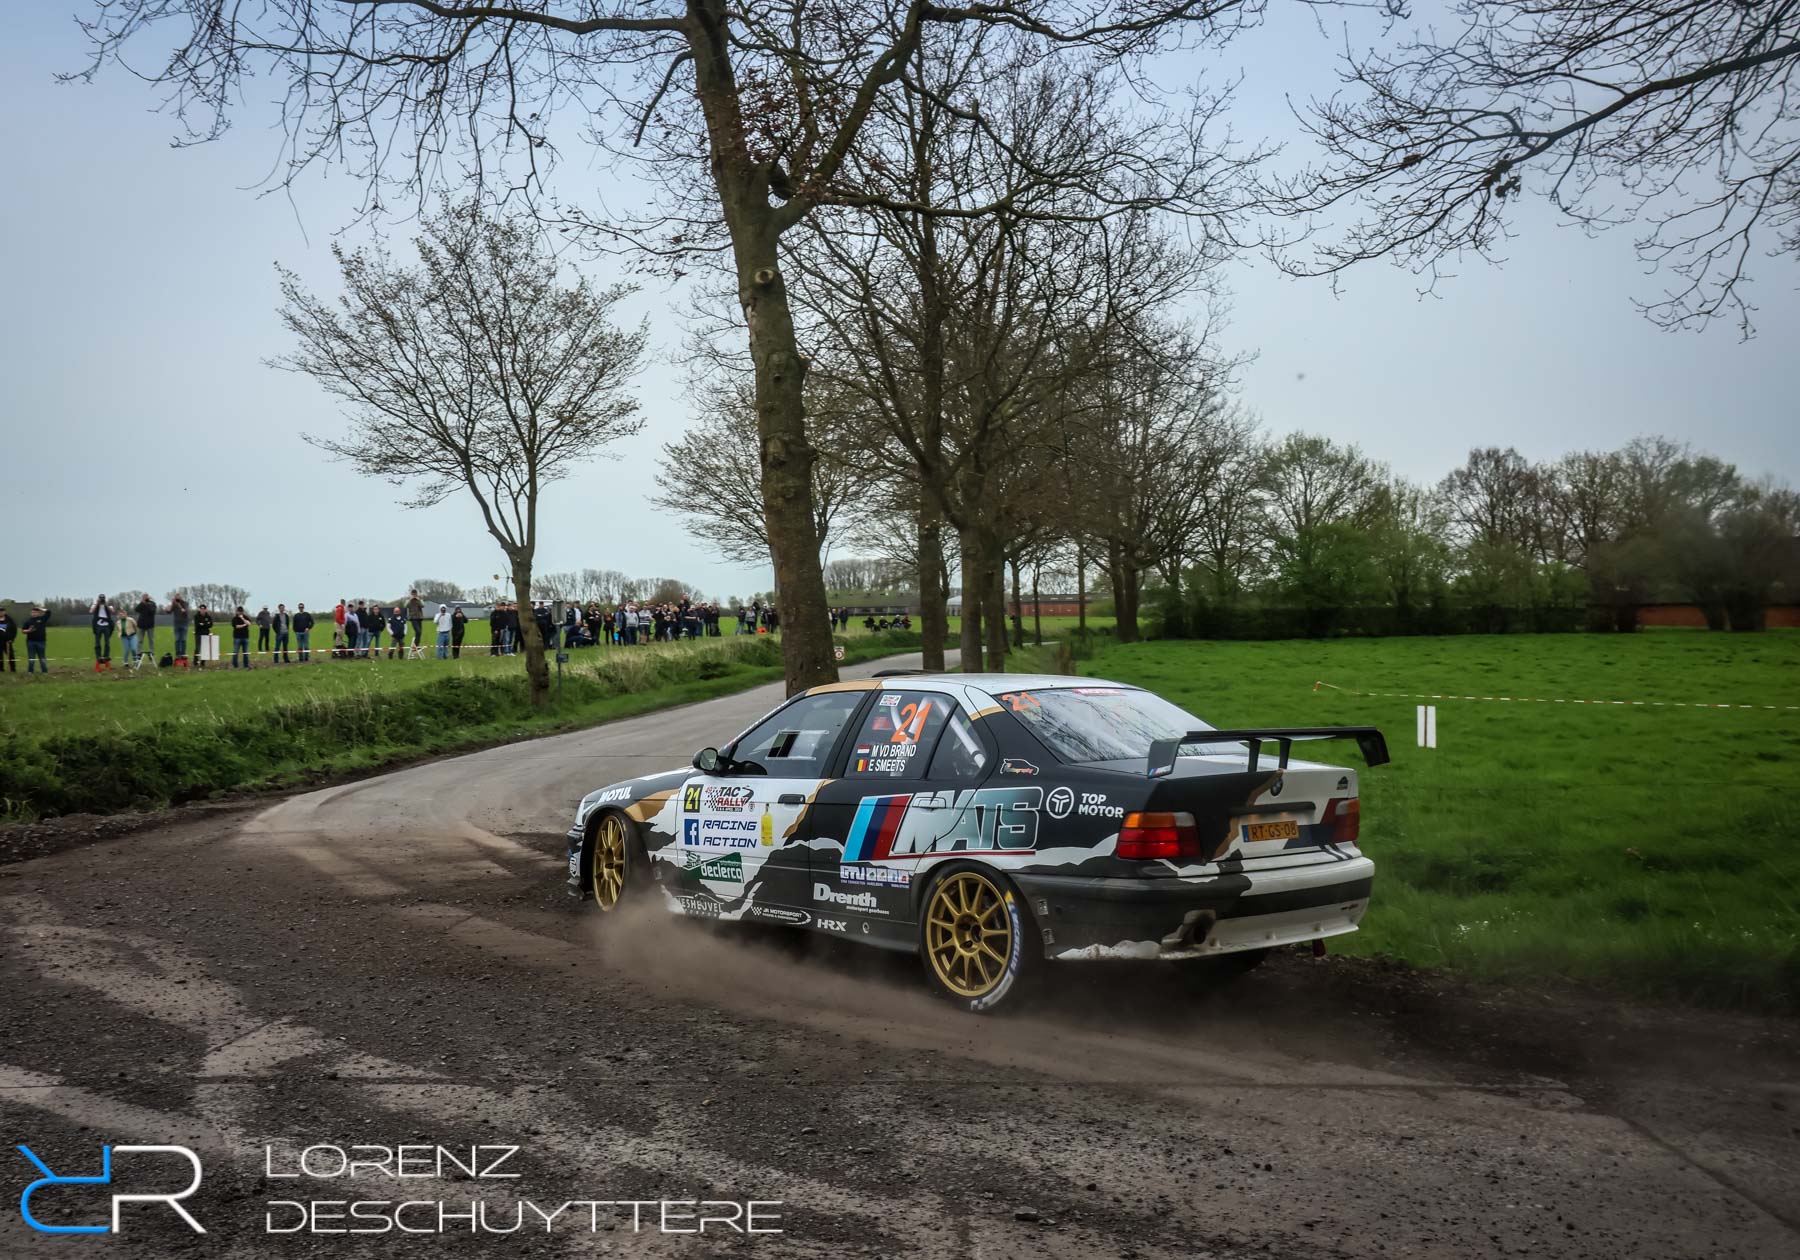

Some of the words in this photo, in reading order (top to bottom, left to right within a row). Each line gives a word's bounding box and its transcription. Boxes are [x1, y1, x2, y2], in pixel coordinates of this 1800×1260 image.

[1002, 692, 1041, 711] 21
[890, 703, 933, 743] 21
[871, 745, 880, 757] M
[880, 745, 890, 757] VD
[891, 744, 917, 757] BRAND
[868, 759, 875, 772] E
[875, 759, 906, 772] SMEETS
[597, 786, 632, 804] MOTUL
[684, 786, 701, 811] 21
[719, 786, 742, 797] TAC
[716, 797, 747, 807] RALLY
[1081, 793, 1107, 805] TOP
[1078, 804, 1124, 819] MOTOR
[702, 819, 758, 831] RACING
[702, 836, 758, 849] ACTION
[700, 861, 744, 883] declercq
[813, 882, 877, 908] Drenth
[817, 918, 847, 932] HRX
